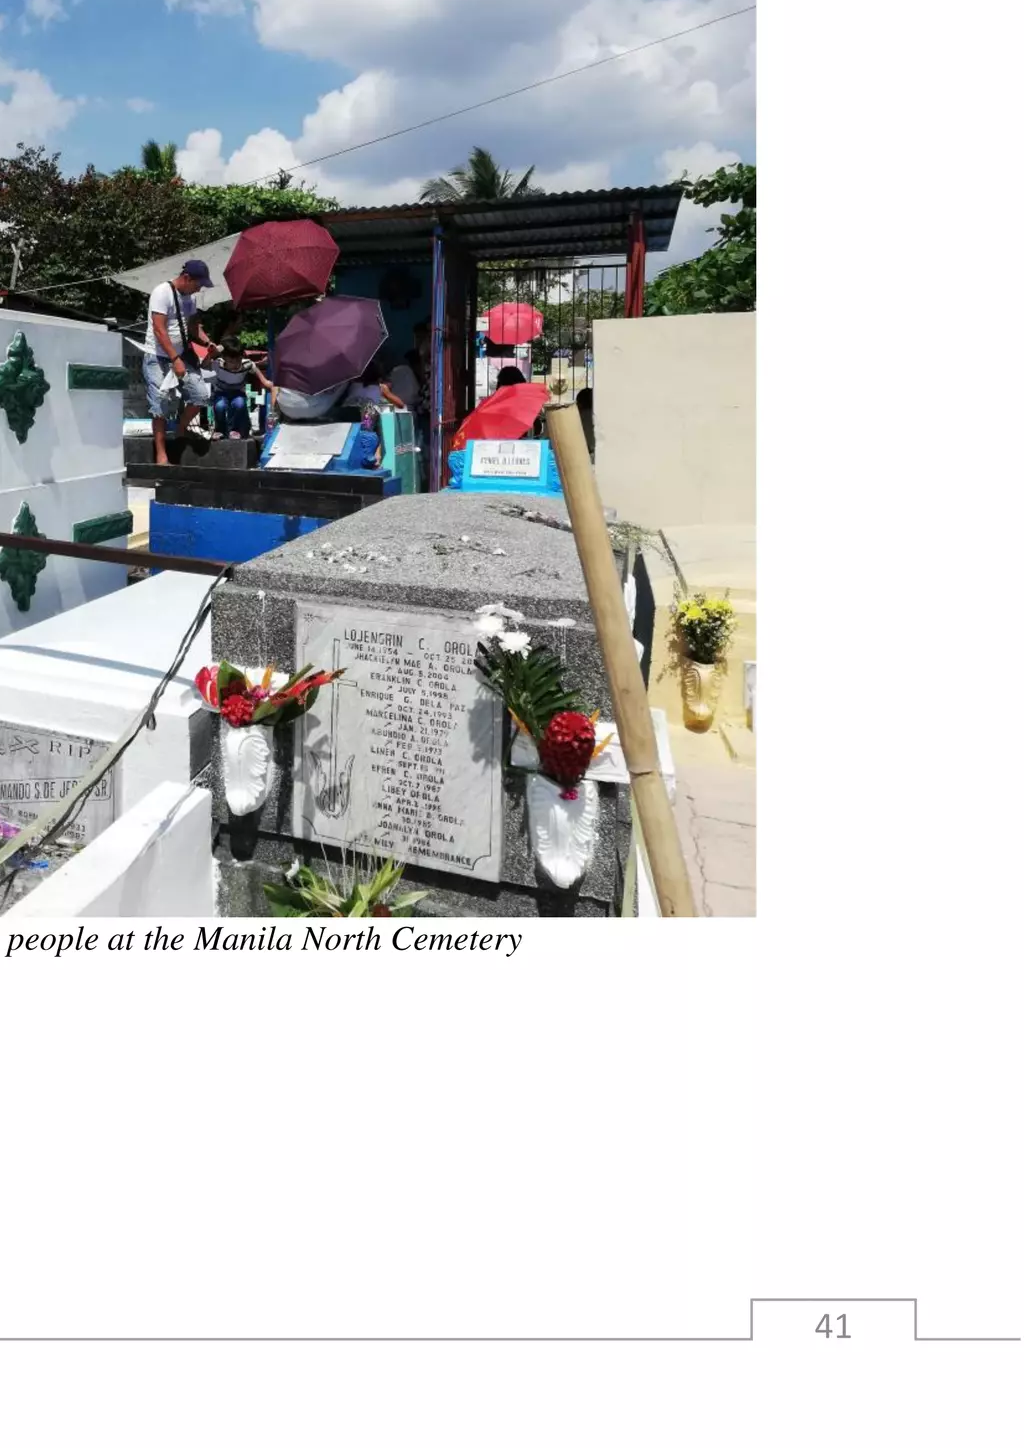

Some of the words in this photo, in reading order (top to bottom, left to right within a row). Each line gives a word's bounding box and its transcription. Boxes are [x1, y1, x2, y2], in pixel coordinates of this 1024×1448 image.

[360, 688, 394, 702] ENRIQUE
[420, 698, 442, 709] DELA
[5, 926, 99, 958] people
[108, 931, 136, 951] at
[145, 926, 185, 951] the
[194, 926, 293, 951] Manila
[302, 926, 382, 951] North
[393, 926, 523, 958] Cemetery
[815, 1314, 851, 1338] 41
